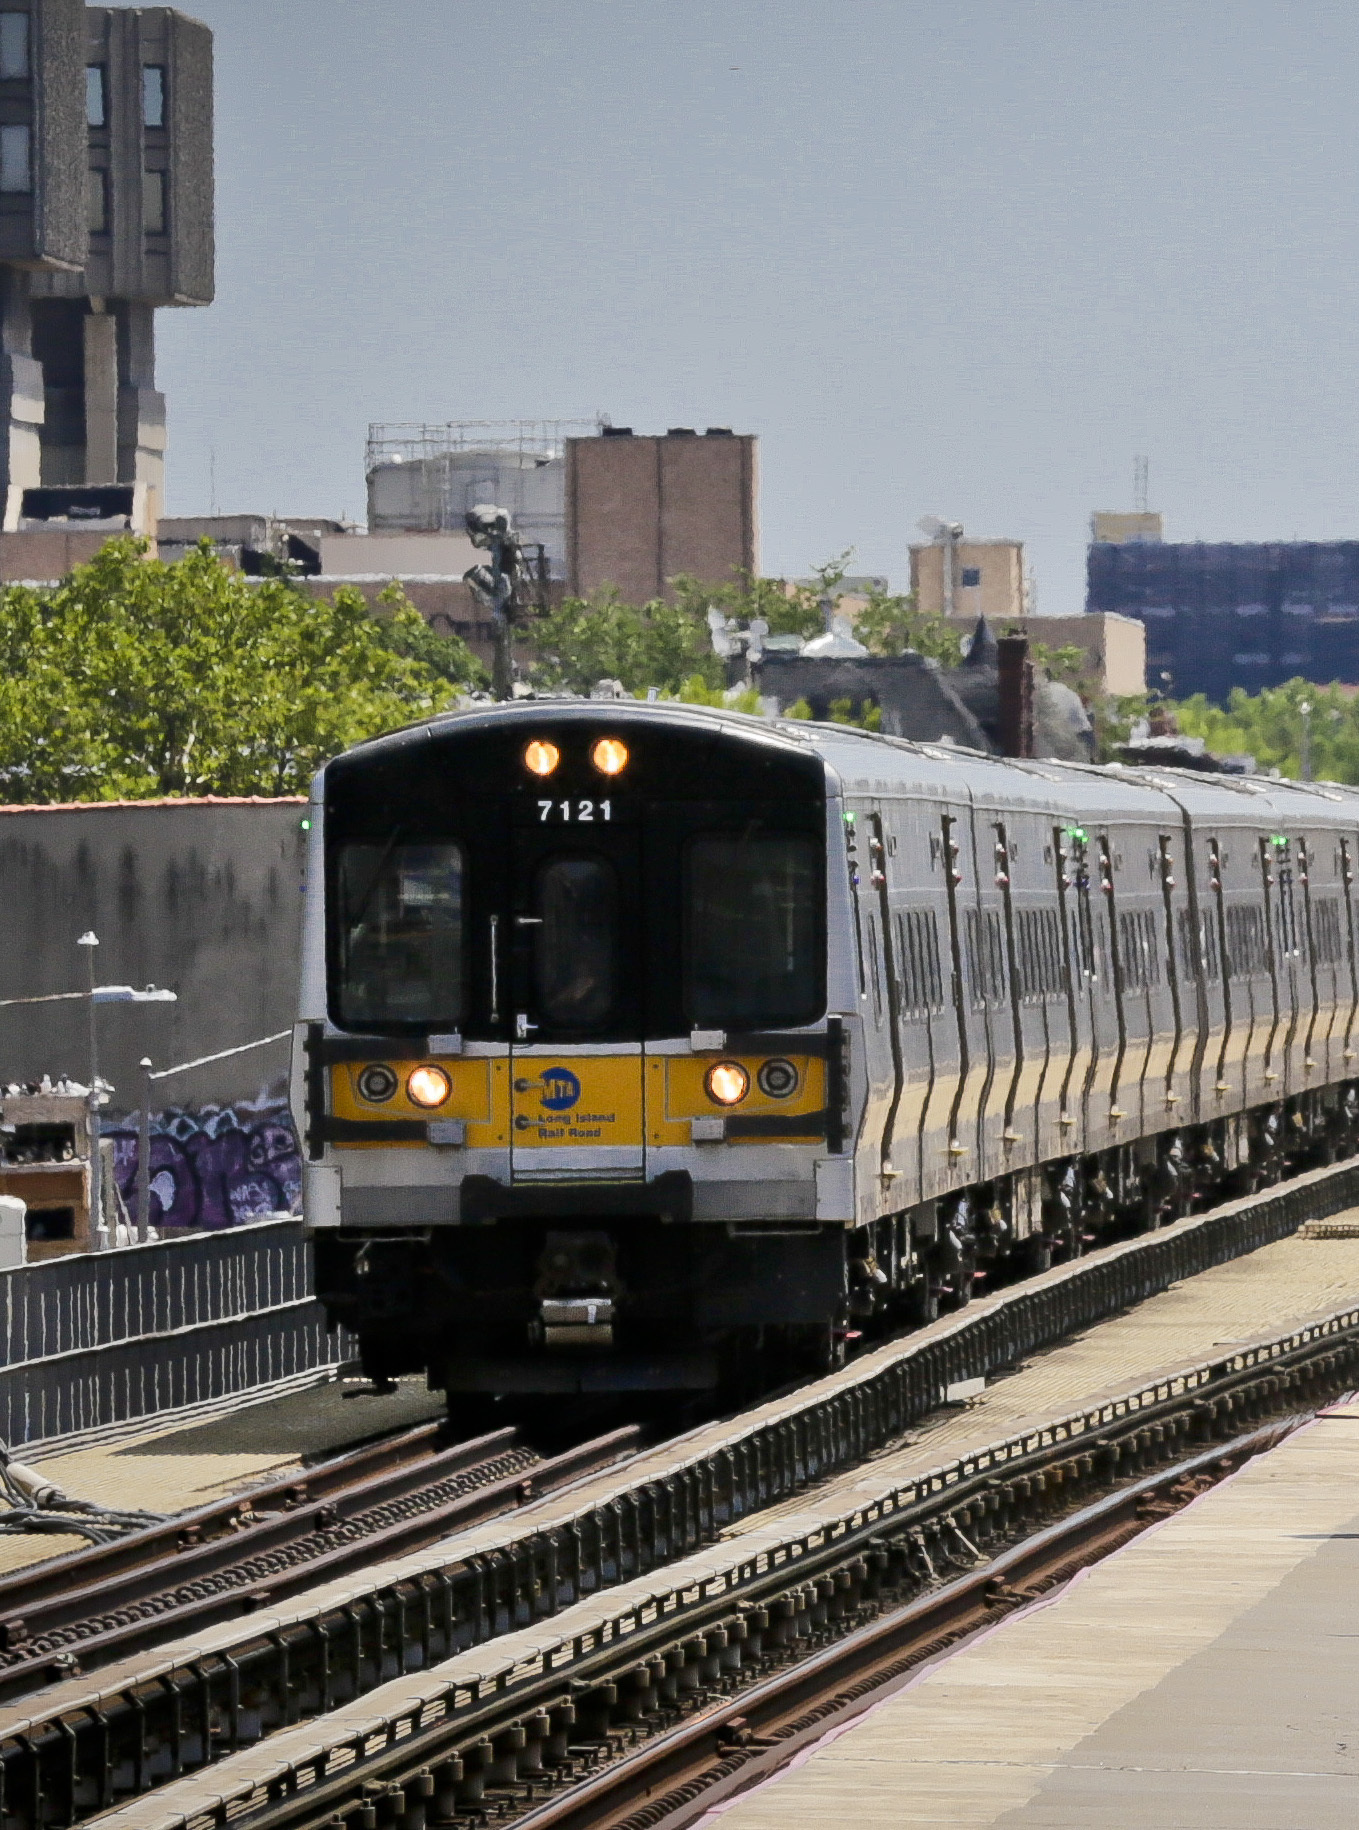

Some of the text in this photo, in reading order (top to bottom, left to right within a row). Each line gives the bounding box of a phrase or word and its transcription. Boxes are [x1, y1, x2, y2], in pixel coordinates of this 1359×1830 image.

[537, 800, 611, 821] 7121
[576, 1112, 616, 1123] Island
[538, 1127, 602, 1138] Rail Road
